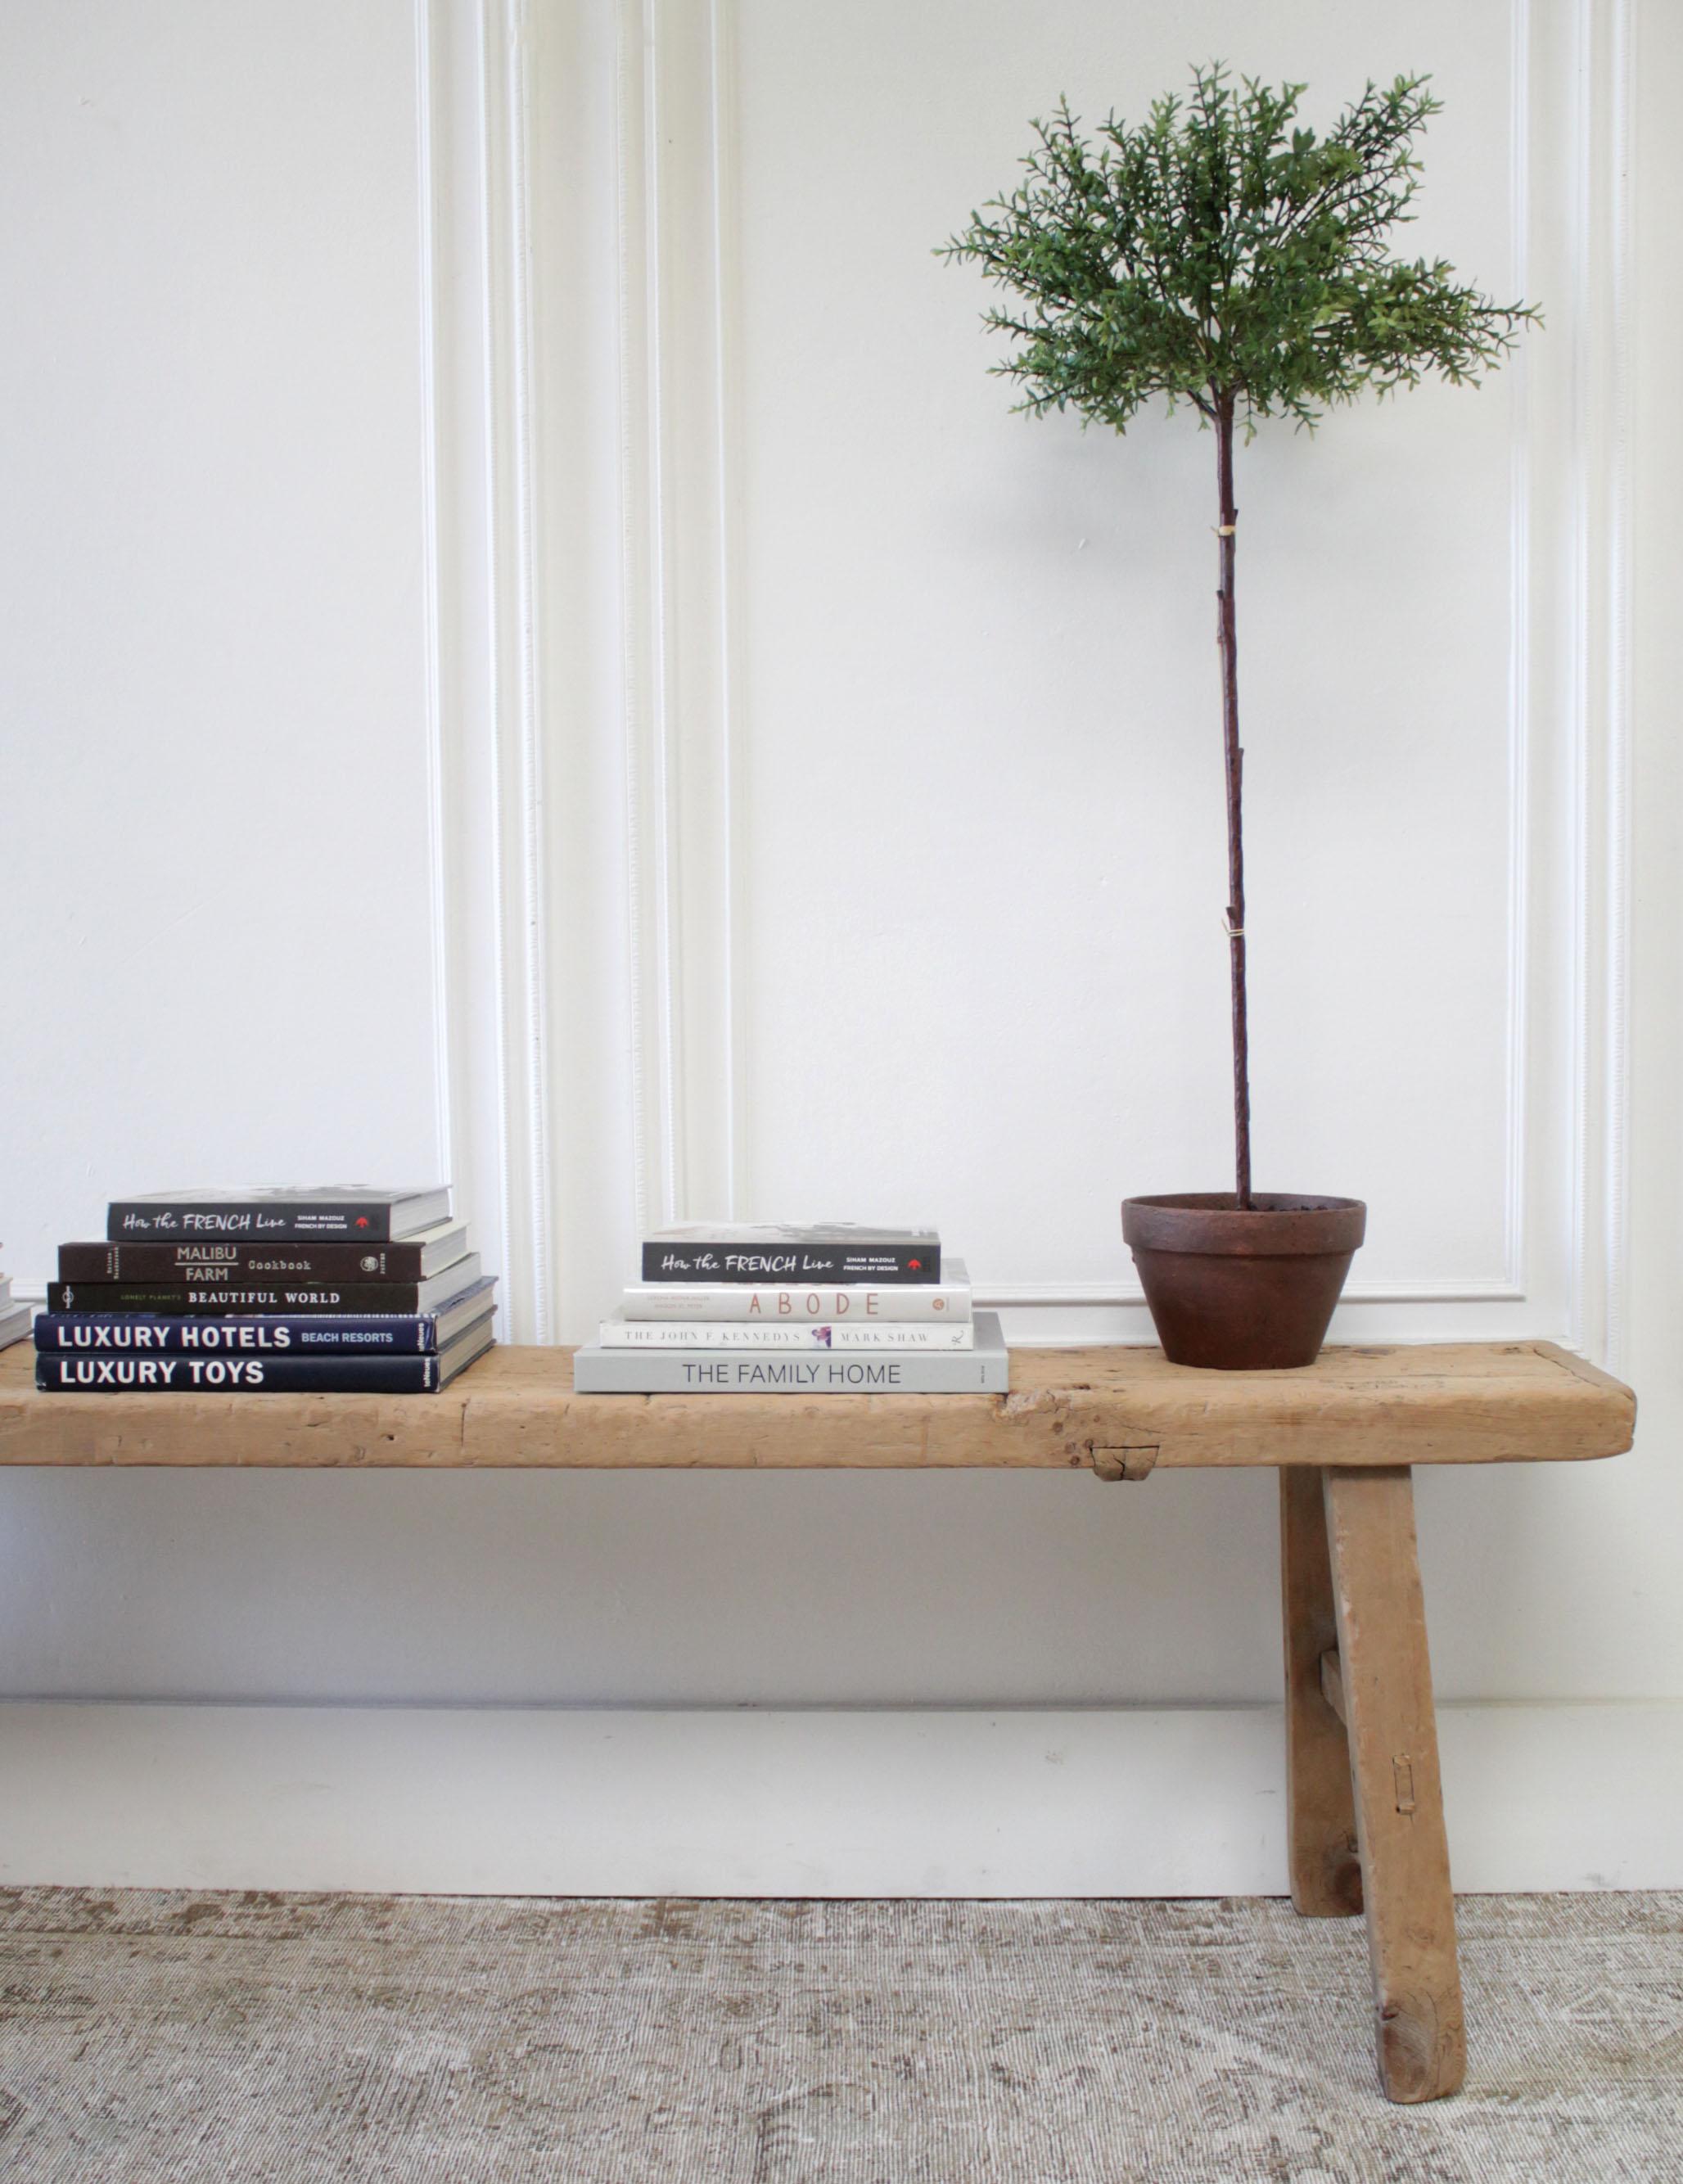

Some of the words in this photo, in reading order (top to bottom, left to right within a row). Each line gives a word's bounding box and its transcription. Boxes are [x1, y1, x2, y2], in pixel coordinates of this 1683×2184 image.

[123, 1213, 151, 1230] How
[153, 1212, 178, 1229] the
[183, 1214, 251, 1231] FRENCH
[256, 1213, 287, 1229] Live
[177, 1247, 237, 1260] MALIBU
[661, 1254, 692, 1270] How
[693, 1253, 720, 1270] the
[724, 1255, 796, 1272] FRENCH
[802, 1255, 834, 1270] Live
[186, 1268, 228, 1281] FARM
[248, 1261, 311, 1270] Cookbook
[188, 1292, 277, 1303] BEAUTIFUL
[285, 1292, 341, 1303] WORLD
[749, 1293, 878, 1315] ABODE
[57, 1326, 170, 1347] LUXURY
[181, 1326, 291, 1347] HOTELS
[301, 1333, 339, 1342] BEACH
[341, 1333, 393, 1342] RESORTS
[625, 1331, 653, 1340] THE
[660, 1331, 698, 1340] JOHN
[722, 1331, 800, 1342] KENNEDYS
[840, 1332, 882, 1342] MARK
[887, 1333, 928, 1342] SHAW
[60, 1360, 177, 1383] LUXURY
[188, 1360, 264, 1384] TOYS
[682, 1364, 729, 1383] THE
[738, 1364, 820, 1383] FAMILY
[829, 1364, 901, 1383] HOME
